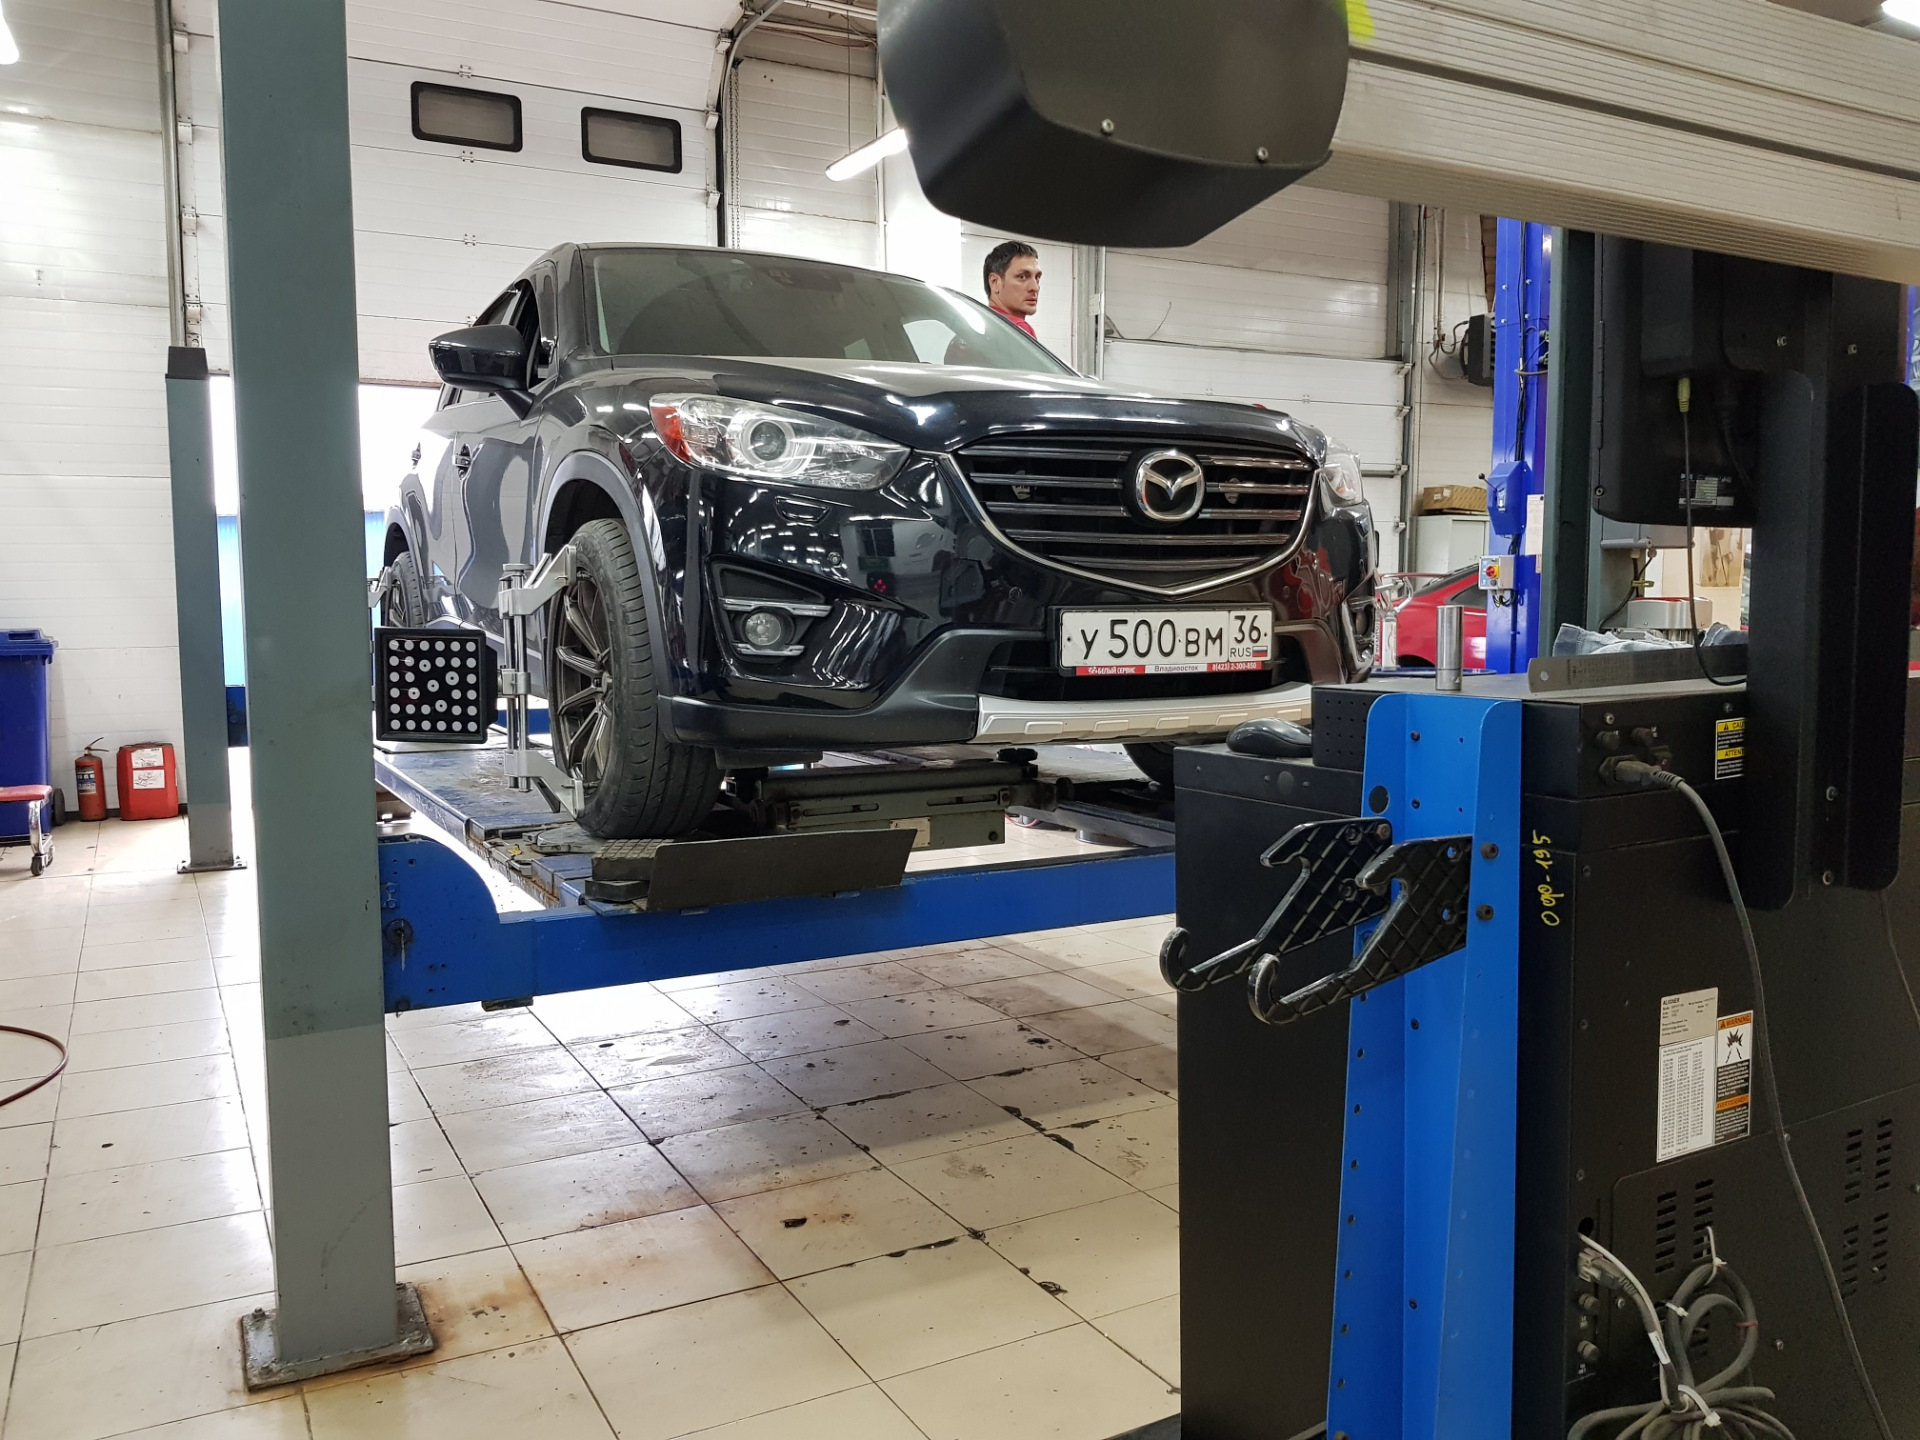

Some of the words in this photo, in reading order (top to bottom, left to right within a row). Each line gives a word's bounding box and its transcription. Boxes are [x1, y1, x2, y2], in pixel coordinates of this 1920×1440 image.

[1233, 614, 1262, 644] 36
[1229, 647, 1252, 658] RUS
[1154, 665, 1199, 673] Владивосток
[1725, 1013, 1751, 1027] WARNING
